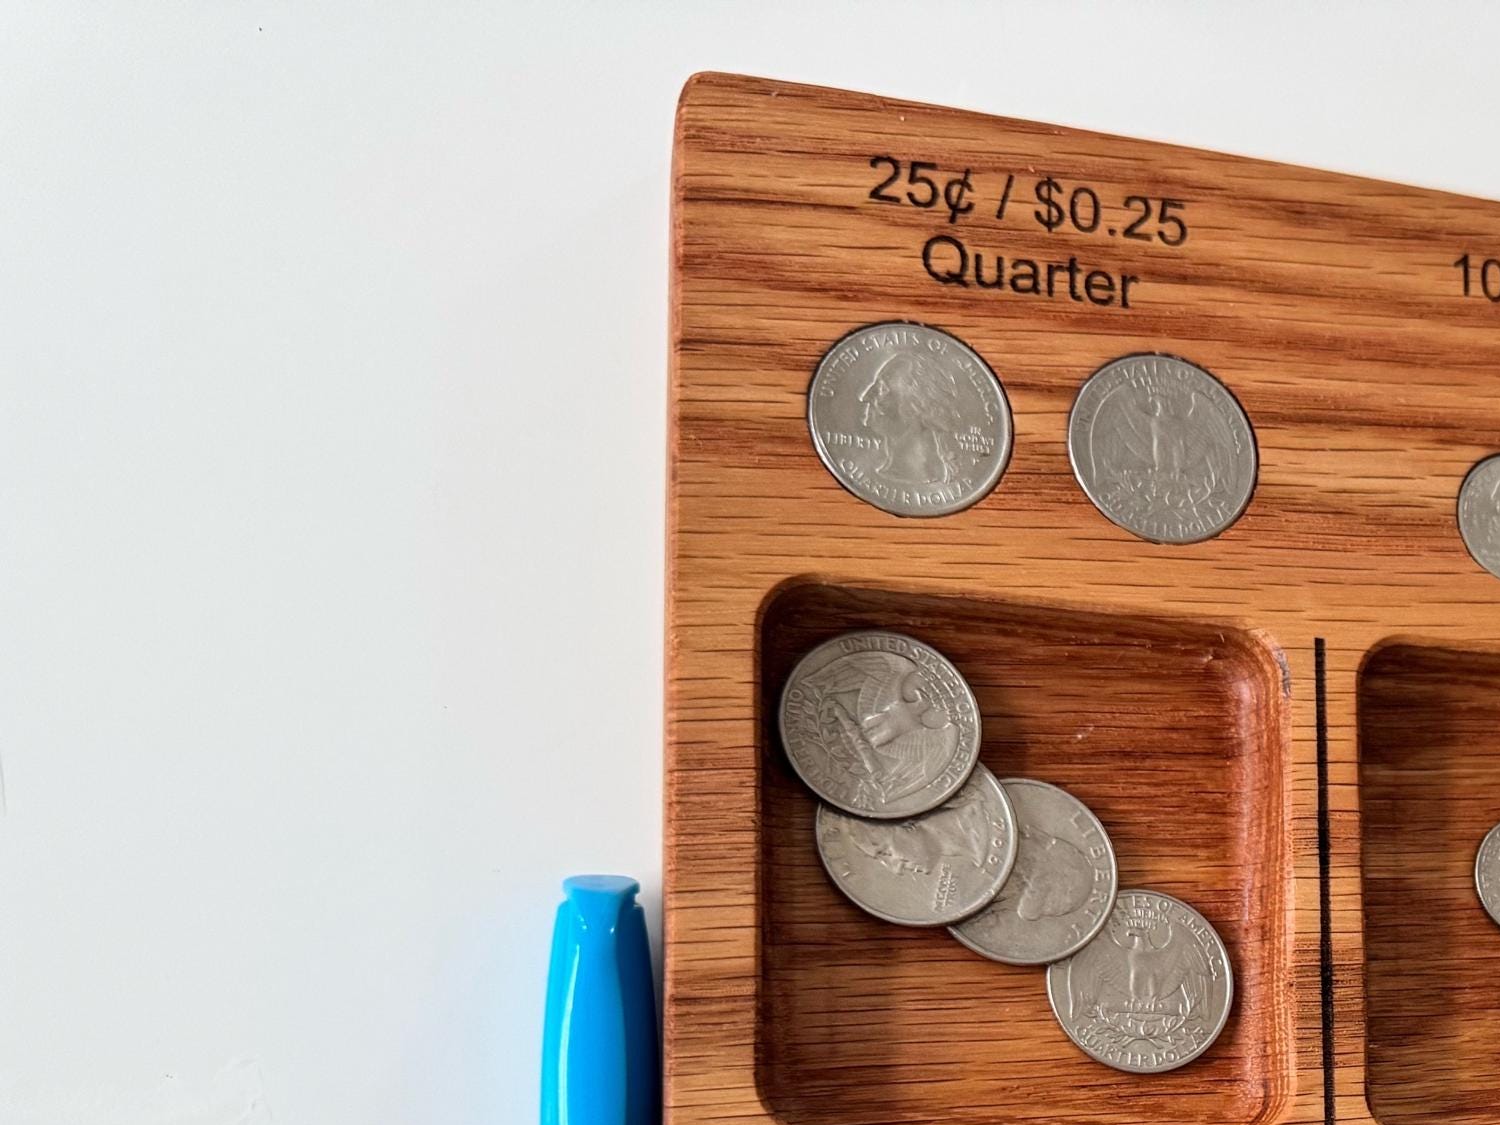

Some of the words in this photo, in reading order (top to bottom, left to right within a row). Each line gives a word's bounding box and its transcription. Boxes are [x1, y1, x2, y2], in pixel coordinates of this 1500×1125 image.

[868, 155, 974, 224] 25¢
[996, 173, 1014, 220] /
[1034, 175, 1189, 247] $0.25
[922, 235, 1141, 309] Quarter
[840, 634, 911, 652] UNITED
